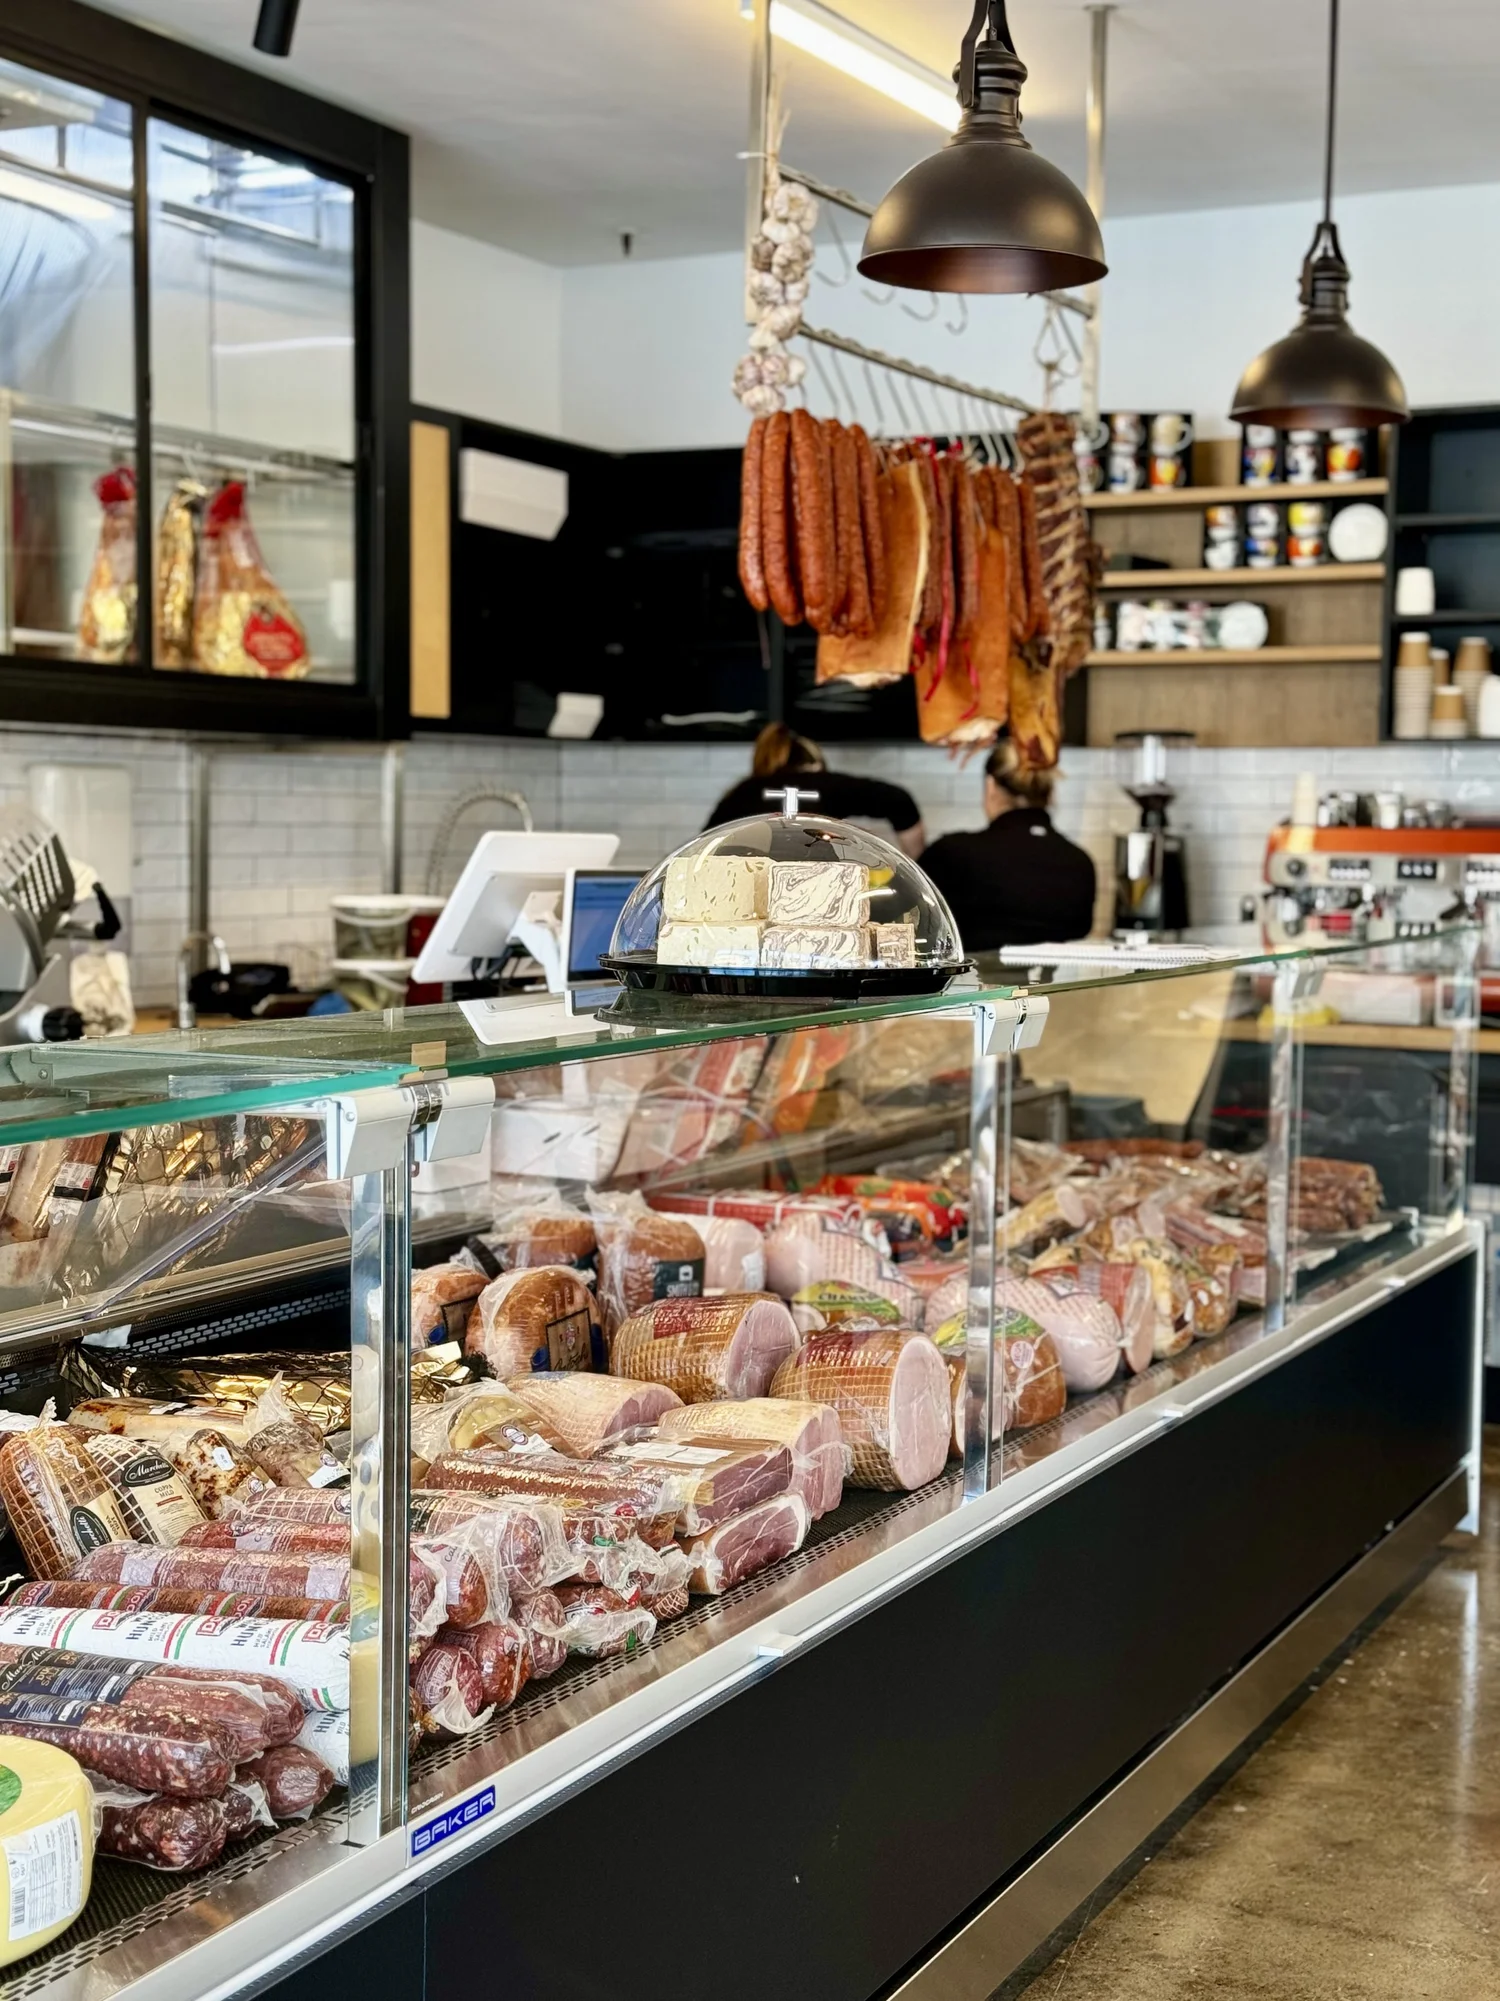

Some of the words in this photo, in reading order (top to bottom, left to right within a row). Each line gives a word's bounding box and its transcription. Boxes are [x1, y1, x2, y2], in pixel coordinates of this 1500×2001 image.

[154, 1484, 174, 1494] COPPA
[159, 1489, 175, 1498] MILD
[414, 1792, 495, 1852] BAKER
